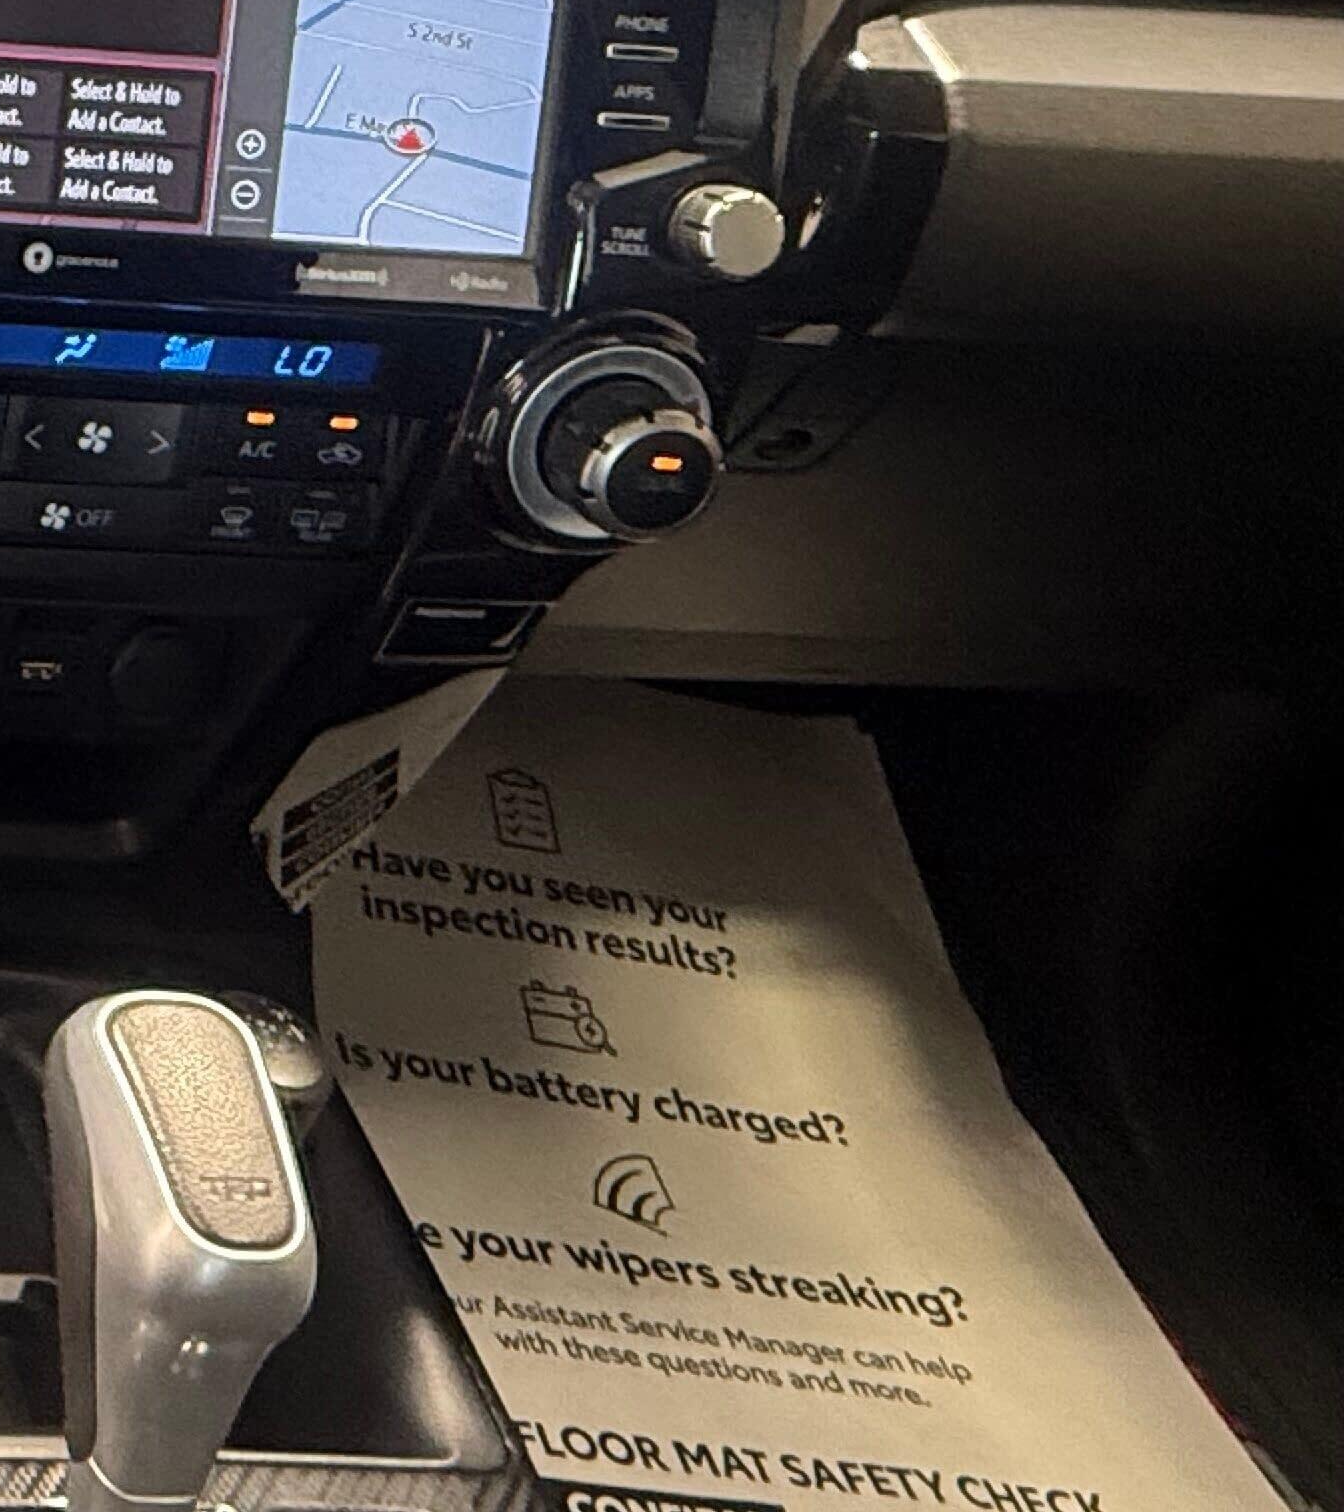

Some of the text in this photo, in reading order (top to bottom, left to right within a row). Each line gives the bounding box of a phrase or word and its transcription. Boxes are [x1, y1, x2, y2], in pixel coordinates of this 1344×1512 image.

[21, 77, 37, 96] to
[70, 78, 182, 107] Select & Hold to
[67, 108, 97, 131] Add
[13, 147, 30, 166] to
[64, 146, 174, 175] Select & Hold to
[60, 177, 90, 201] Add
[274, 343, 332, 377] LO
[239, 439, 275, 460] A/C
[76, 509, 114, 527] OFF
[352, 841, 728, 933] Have you seen your
[362, 885, 737, 980] inspection results?
[334, 1032, 850, 1148] Is your battery charged?
[449, 1226, 554, 1265] your
[563, 1239, 720, 1289] wipers
[728, 1260, 969, 1329] streaking?
[494, 1294, 618, 1334] Assistant
[619, 1311, 721, 1348] Service
[722, 1325, 846, 1366] Manager
[852, 1350, 904, 1372] can
[907, 1350, 973, 1385] help
[494, 1328, 932, 1408] with these questions and more.
[512, 1419, 1104, 1512] FLOOR MAT SAFETY CHECK
